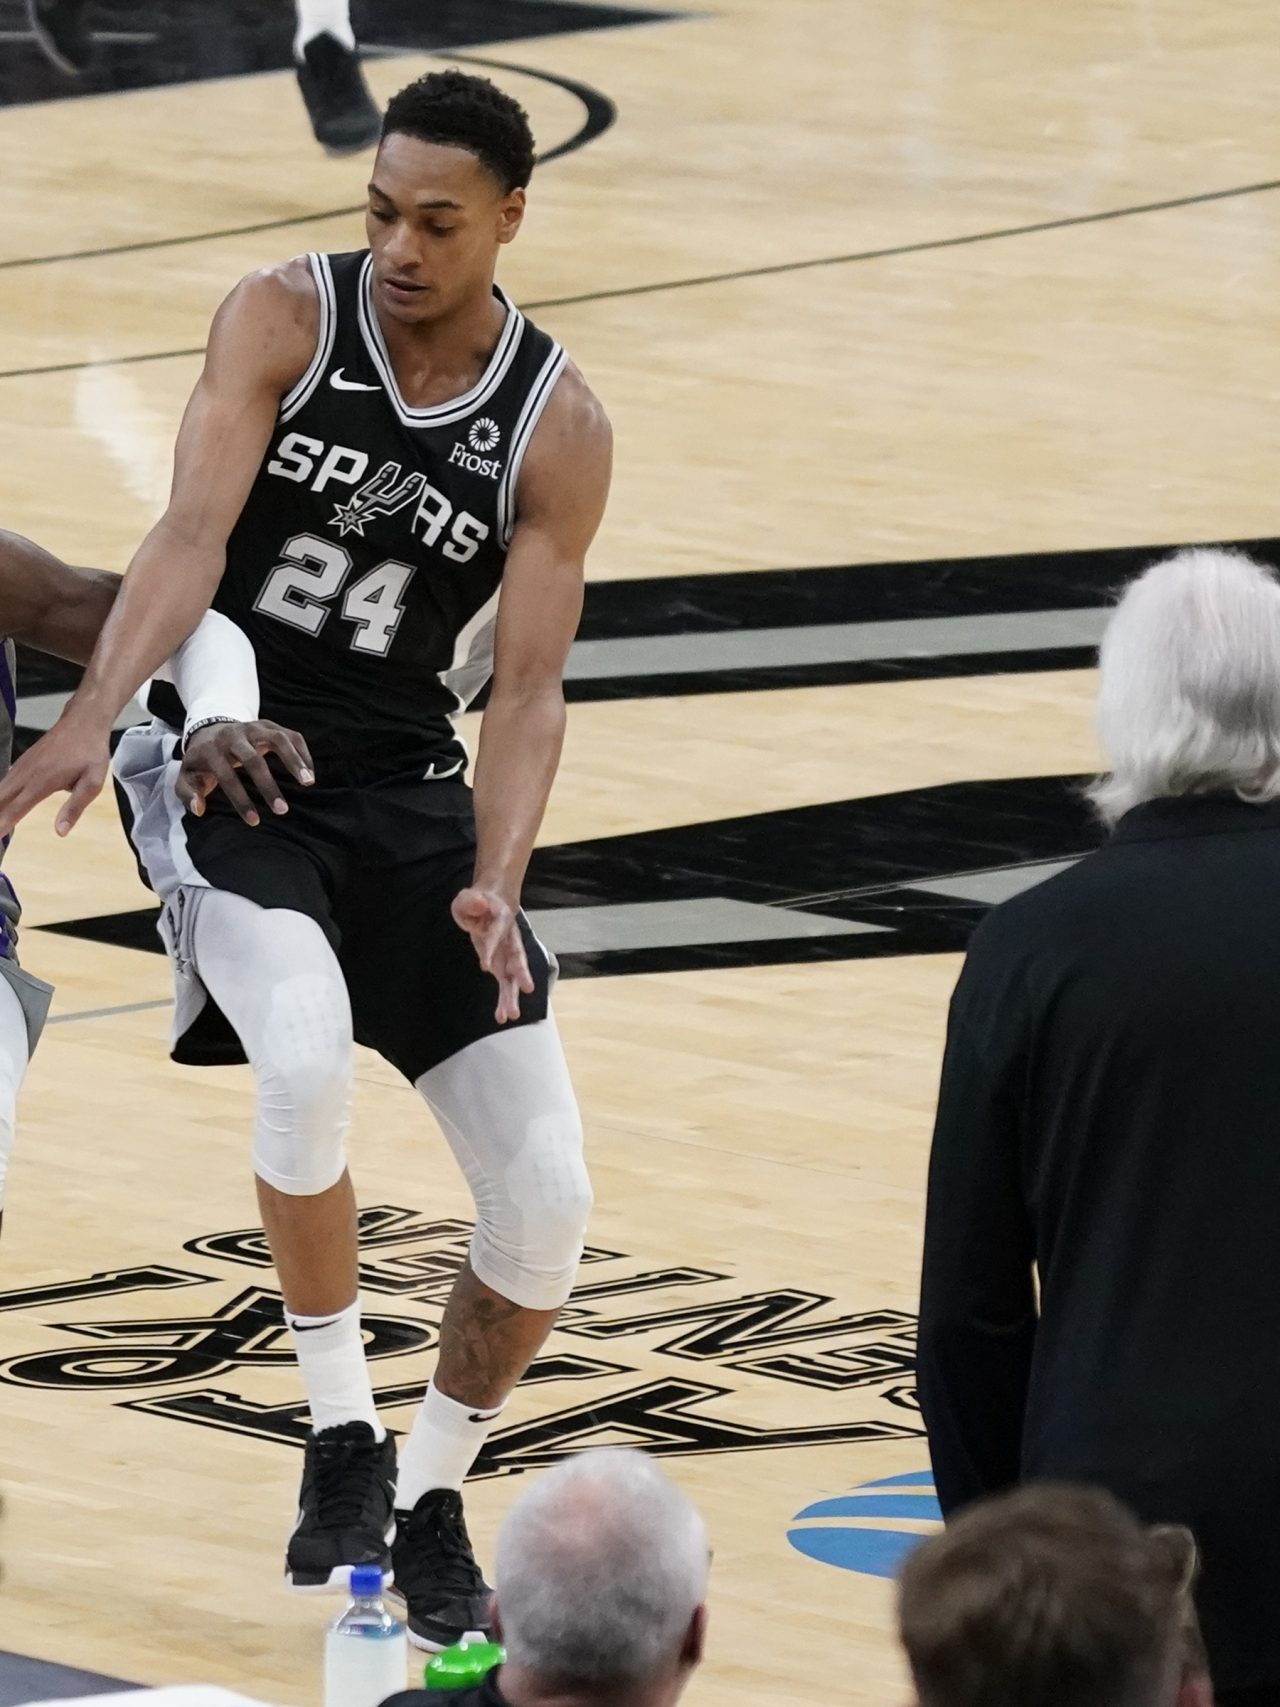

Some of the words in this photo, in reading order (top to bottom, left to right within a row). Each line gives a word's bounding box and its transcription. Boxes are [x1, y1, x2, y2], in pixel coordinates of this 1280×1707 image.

[267, 431, 490, 563] SPURS
[447, 441, 503, 480] Frost
[251, 531, 419, 658] 24
